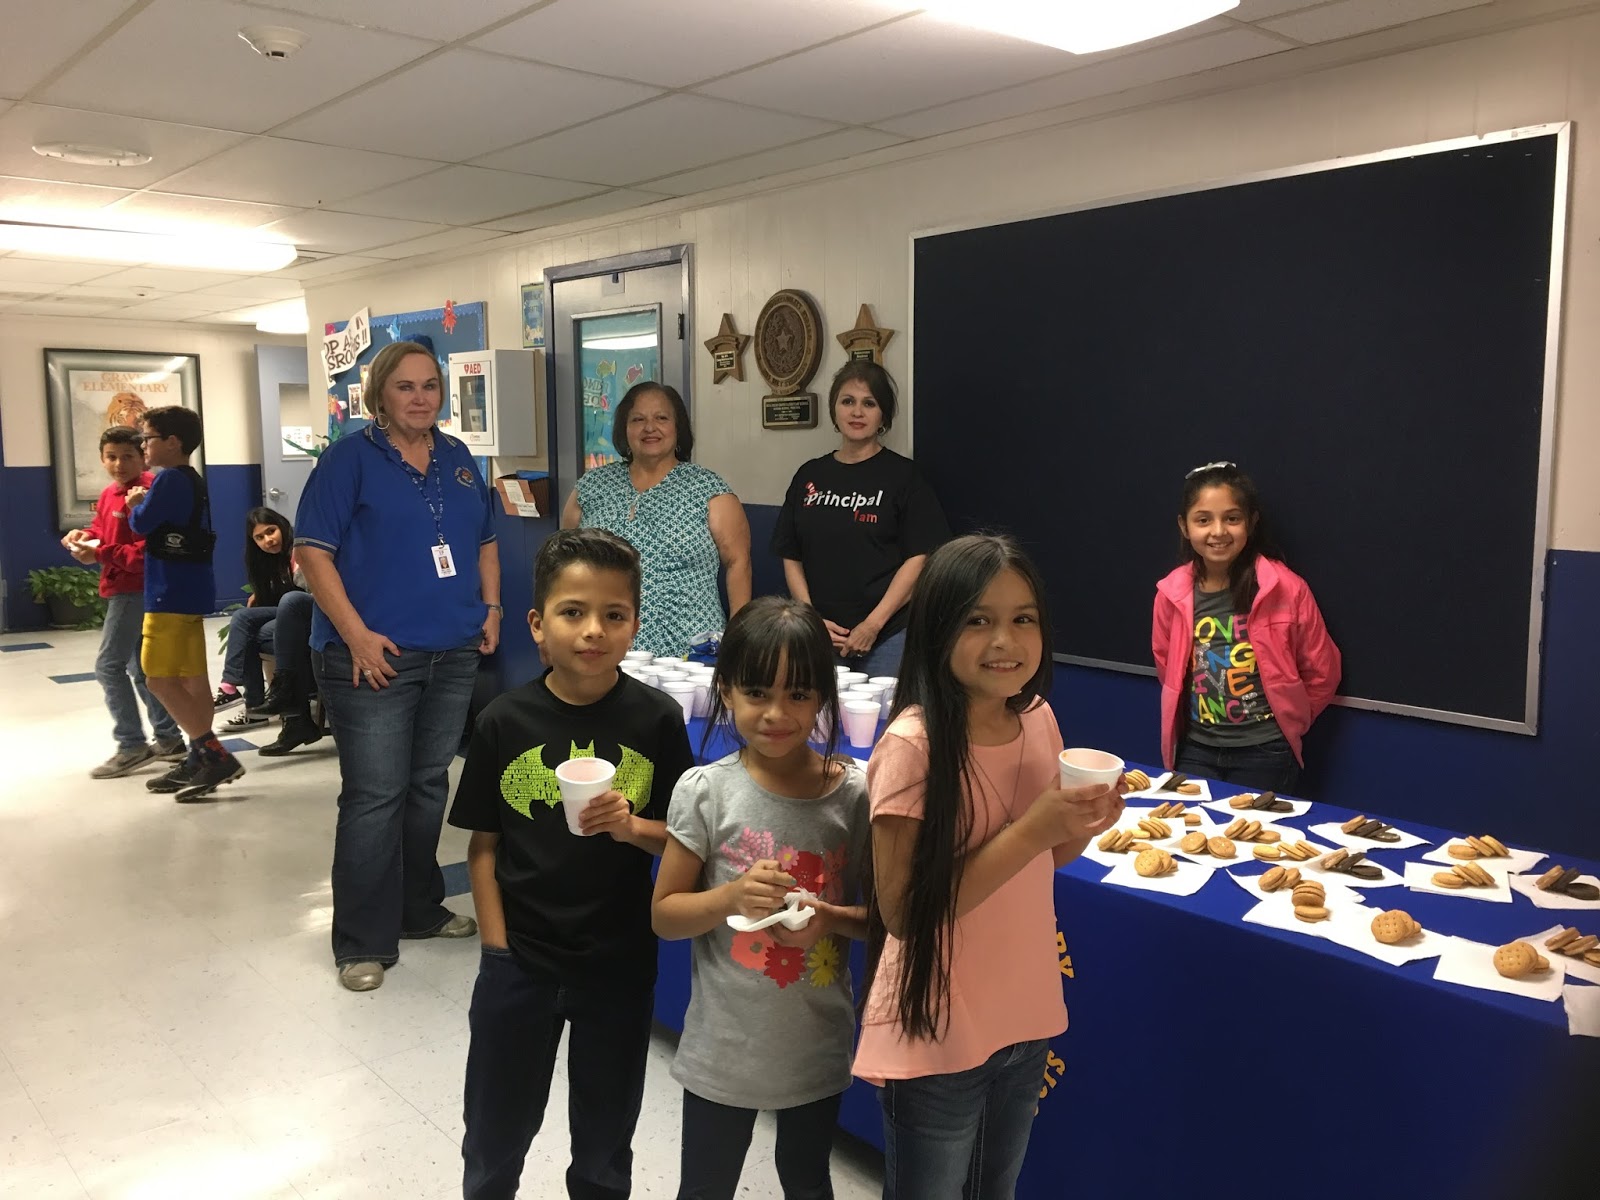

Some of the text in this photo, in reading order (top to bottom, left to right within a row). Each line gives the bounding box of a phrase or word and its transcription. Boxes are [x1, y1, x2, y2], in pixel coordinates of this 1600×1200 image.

[469, 363, 482, 374] AED
[83, 381, 169, 393] ELEMENTARY
[805, 490, 884, 512] Principal
[859, 513, 878, 523] am
[1195, 614, 1249, 643] OVE
[1192, 642, 1257, 673] ING
[534, 790, 562, 800] BATM
